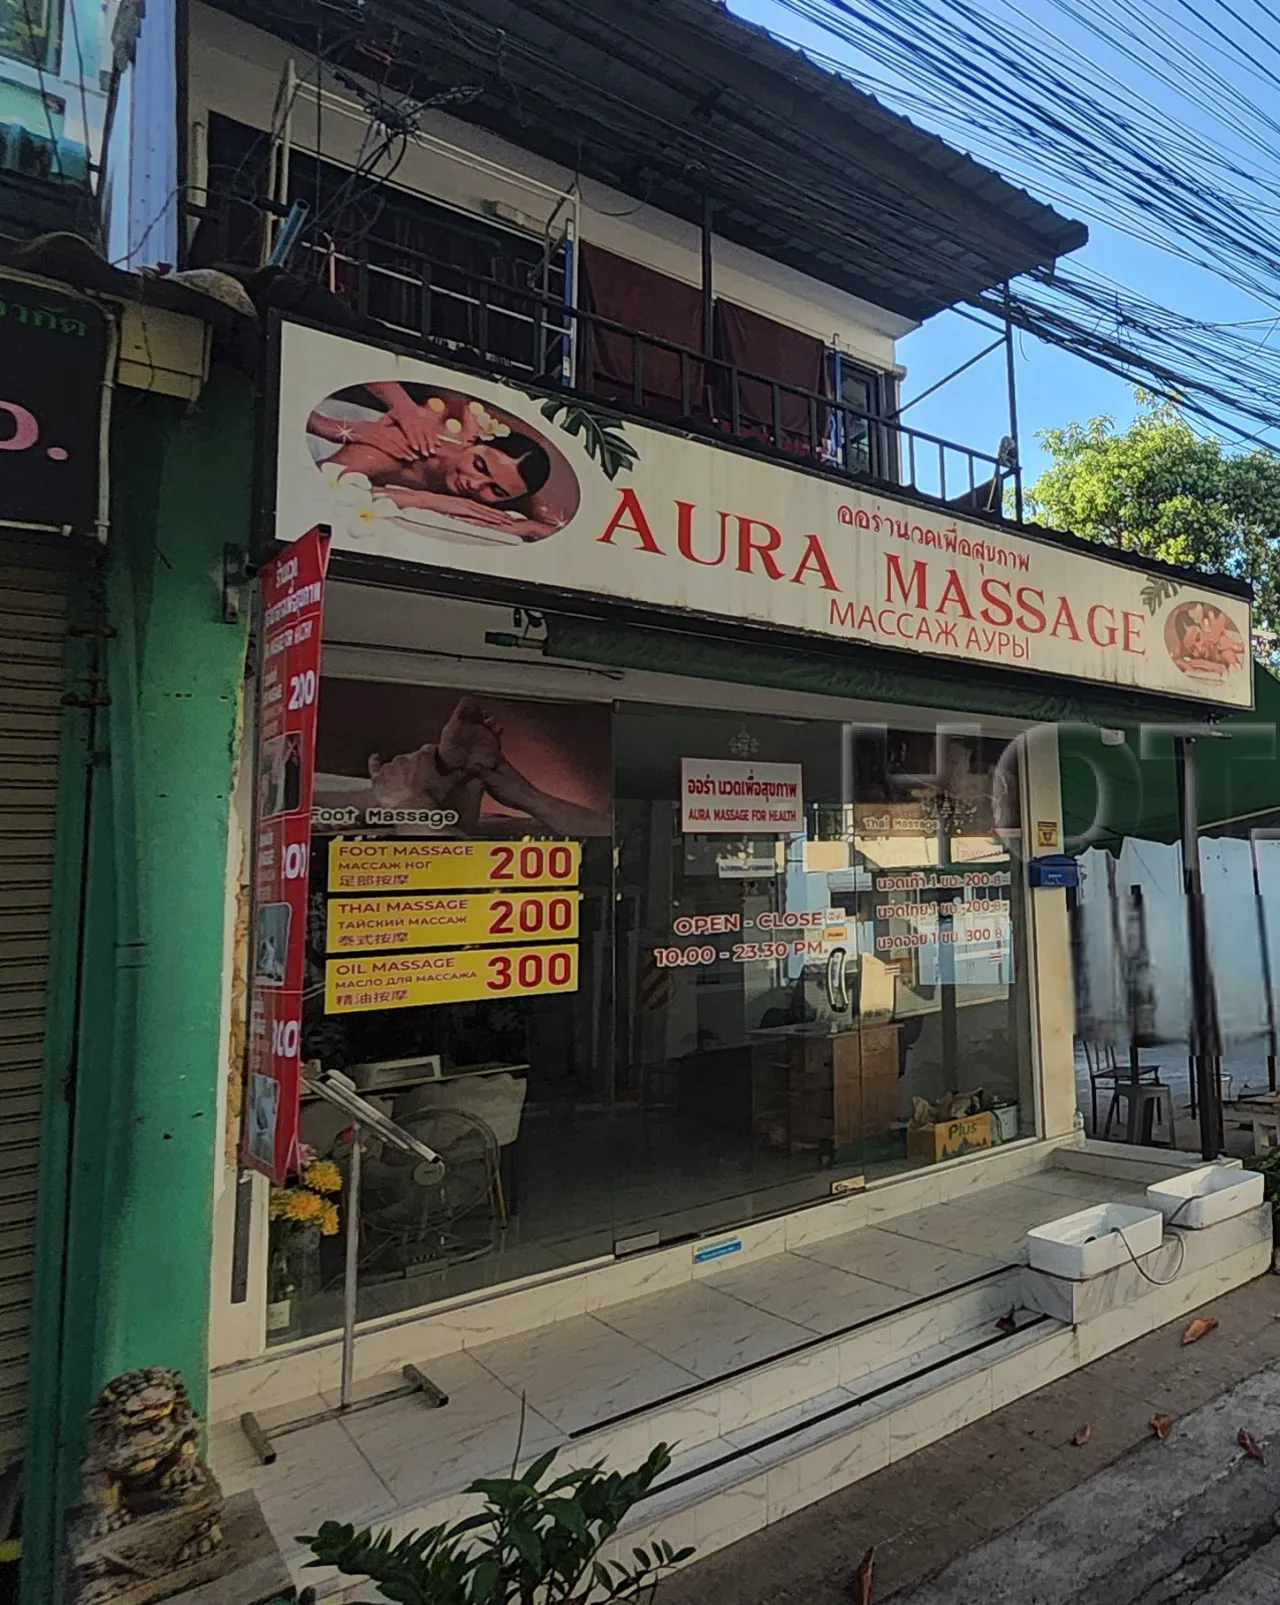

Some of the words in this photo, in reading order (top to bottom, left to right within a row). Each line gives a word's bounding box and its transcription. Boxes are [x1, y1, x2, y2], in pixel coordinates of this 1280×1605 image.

[837, 505, 1031, 575] ออร่านวดเพื่อสุขภาพ
[596, 486, 844, 593] AURA
[882, 552, 1149, 656] MASSAGE
[829, 598, 959, 652] МАССАЖ
[965, 628, 1031, 661] АУРЫ
[718, 769, 797, 803] นวดเพื่อสุขภาพ
[368, 809, 457, 828] Massage
[688, 808, 711, 821] AURA
[713, 808, 750, 821] MASSAGE
[752, 809, 767, 821] FOR
[769, 810, 797, 822] HEALTH
[339, 845, 389, 856] FOOT
[393, 845, 474, 856] MASSAGE
[338, 861, 401, 871] МАССАЖ
[405, 861, 432, 870] НОГ
[489, 846, 572, 880] 200
[965, 873, 990, 886] 200
[338, 903, 381, 915] THAI
[386, 899, 468, 913] MASSAGE
[965, 900, 990, 913] 200
[338, 918, 405, 930] ТАЙСКИЙ
[408, 915, 467, 927] МАССАЖ
[489, 898, 572, 935] 200
[675, 915, 739, 934] OPEN
[758, 912, 822, 929] CLOSE
[966, 929, 991, 942] 300
[656, 947, 714, 966] 10.00
[734, 942, 788, 961] 23.30
[336, 963, 367, 976] OIL
[372, 957, 455, 973] MASSAGE
[486, 952, 572, 991] 300
[335, 978, 383, 989] МАСЛО
[386, 975, 412, 987] ДЛЯ
[416, 971, 478, 983] МАССАЖА
[948, 1123, 977, 1140] Plus
